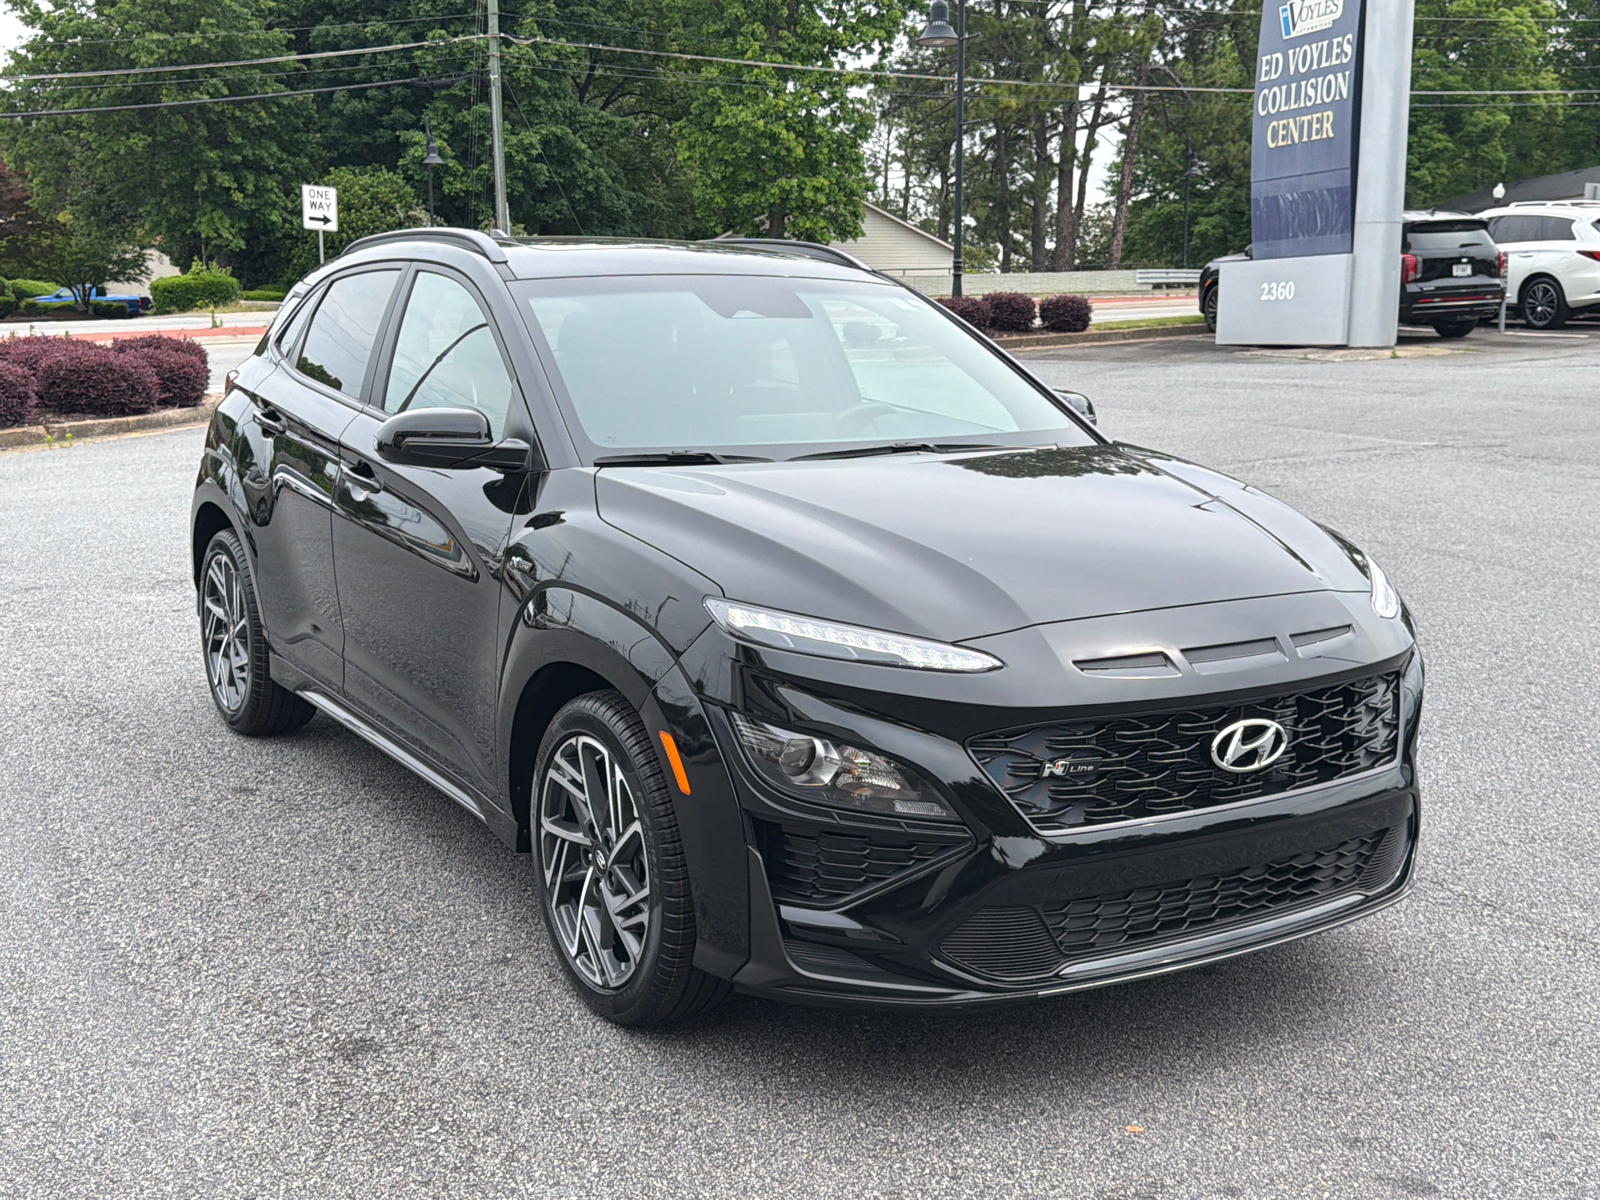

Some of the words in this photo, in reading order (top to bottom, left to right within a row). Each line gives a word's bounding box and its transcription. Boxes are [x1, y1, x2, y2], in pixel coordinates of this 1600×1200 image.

[1289, 0, 1339, 32] VOYLES
[1260, 52, 1283, 82] ED
[1288, 33, 1353, 76] VOYLES
[1258, 71, 1350, 117] COLLISION
[1267, 110, 1334, 149] CENTER
[309, 189, 330, 200] ONE
[309, 200, 331, 211] WAY
[1260, 281, 1295, 300] 2360
